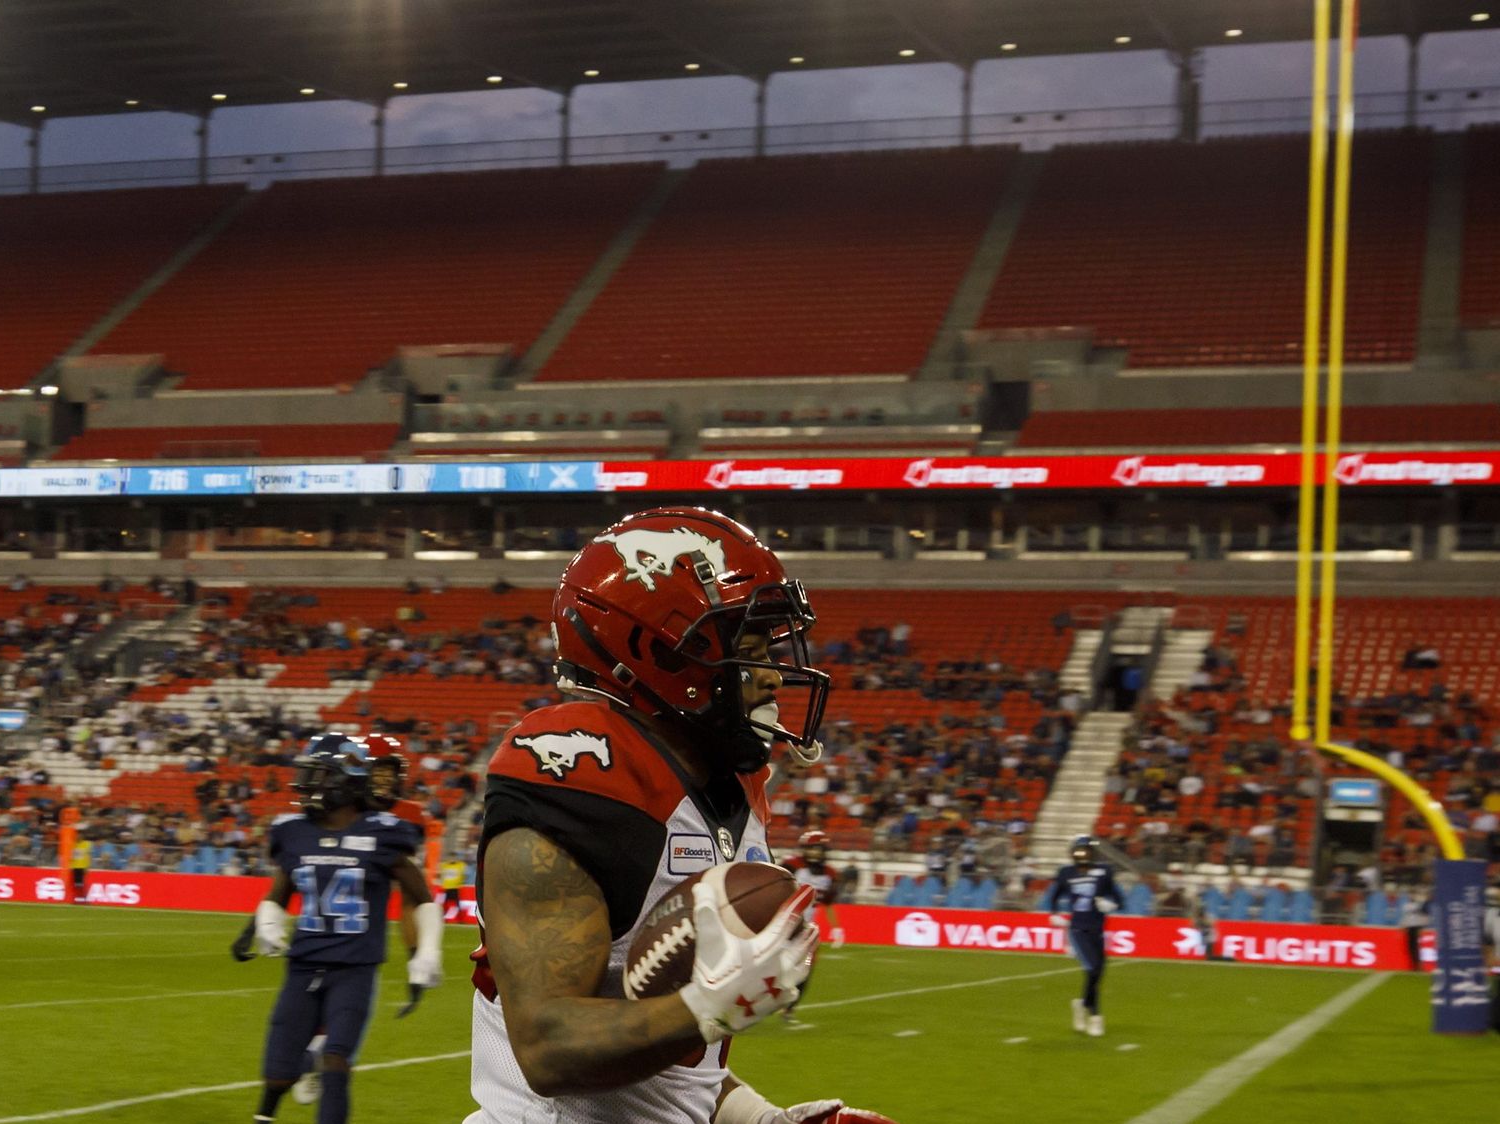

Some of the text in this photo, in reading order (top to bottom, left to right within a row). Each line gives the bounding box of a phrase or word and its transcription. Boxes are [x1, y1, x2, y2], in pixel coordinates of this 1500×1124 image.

[674, 847, 712, 856] BFGoodrich
[86, 883, 141, 904] ARS
[291, 866, 370, 933] 14
[943, 924, 1136, 954] VACATIS
[1222, 935, 1377, 966] FLIGHTS
